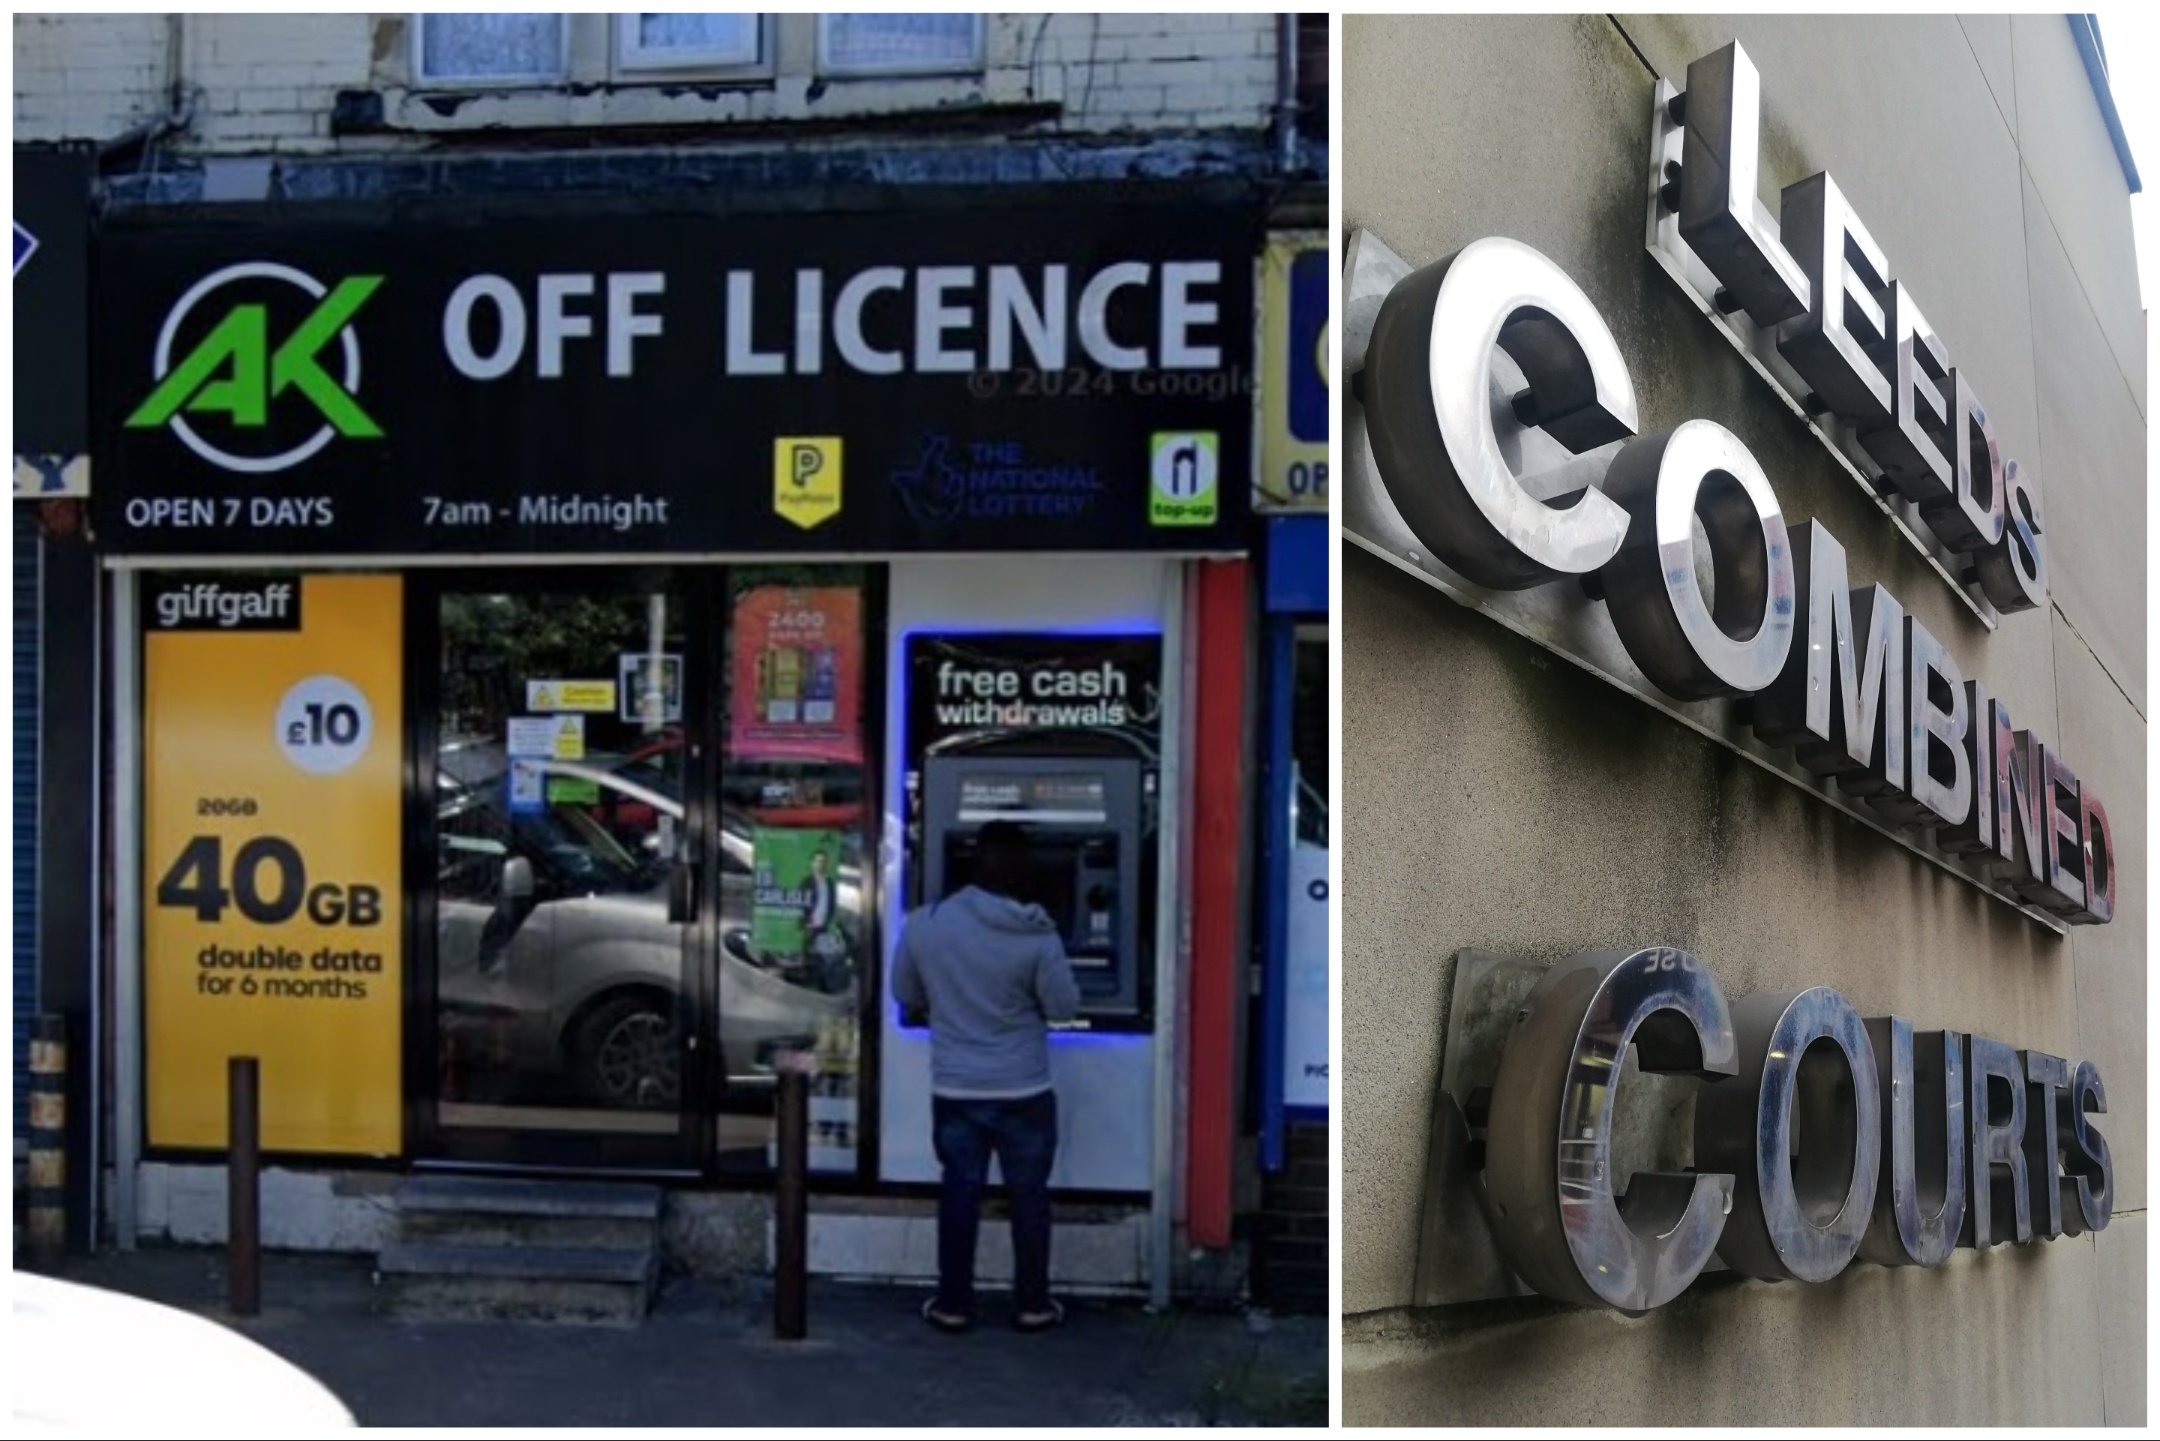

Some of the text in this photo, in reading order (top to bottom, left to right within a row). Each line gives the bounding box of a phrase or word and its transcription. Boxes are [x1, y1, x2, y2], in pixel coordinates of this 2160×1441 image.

[443, 261, 1222, 380] OFF LICENCE
[1678, 38, 2046, 614] LEEDS
[123, 276, 386, 436] AK
[970, 441, 1023, 463] THE
[968, 467, 1103, 491] NATIONAL
[126, 498, 334, 527] OPEN 7 DAYS
[424, 497, 490, 525] 7am
[519, 495, 669, 530] Midnight
[968, 494, 1093, 518] LOTTERY
[1154, 502, 1214, 521] top-up
[1364, 236, 2115, 925] COMBINED
[157, 583, 291, 626] giffgaff
[937, 662, 1127, 697] free cash
[286, 703, 361, 746] £10
[937, 698, 1127, 726] withdrawals
[197, 944, 382, 973] double data
[197, 973, 368, 999] for 6 months
[1486, 947, 2114, 1317] COURTS
